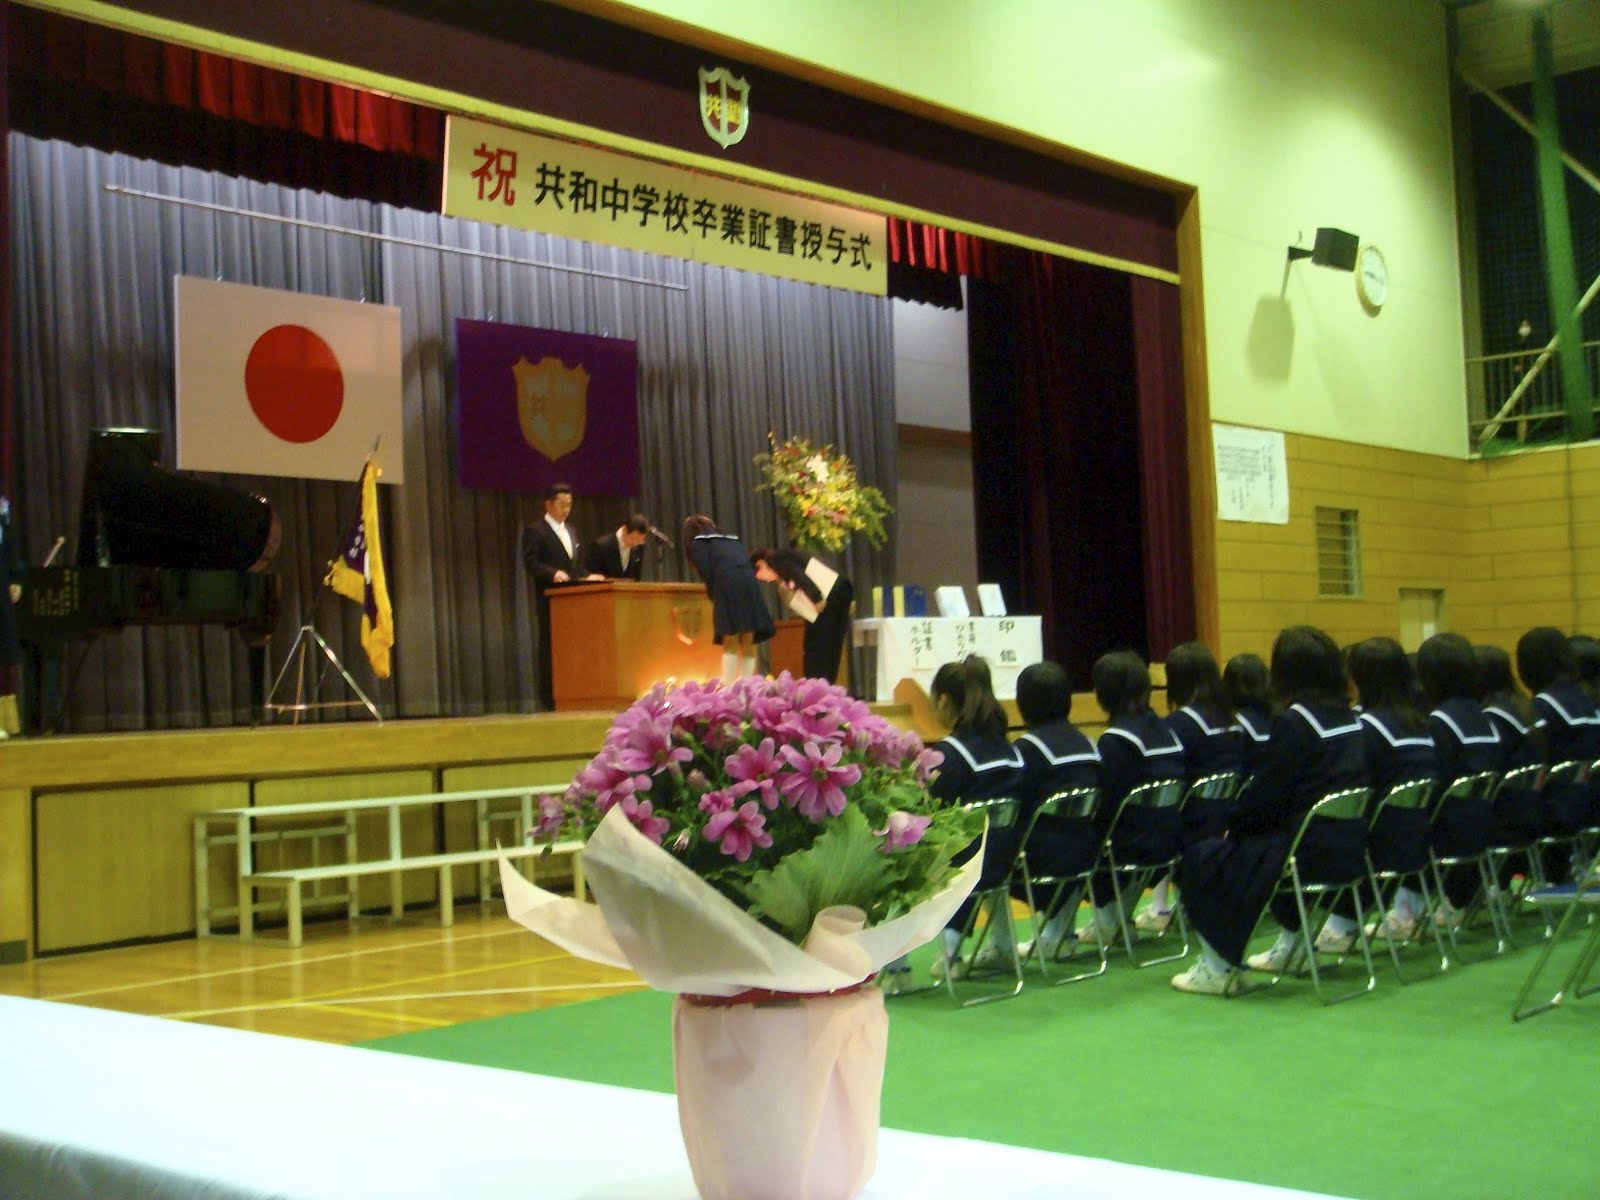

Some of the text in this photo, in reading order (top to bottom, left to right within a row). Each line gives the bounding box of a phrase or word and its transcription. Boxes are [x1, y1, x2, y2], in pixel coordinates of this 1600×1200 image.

[471, 142, 873, 272] 祝 共和中学校卒業証書授与式
